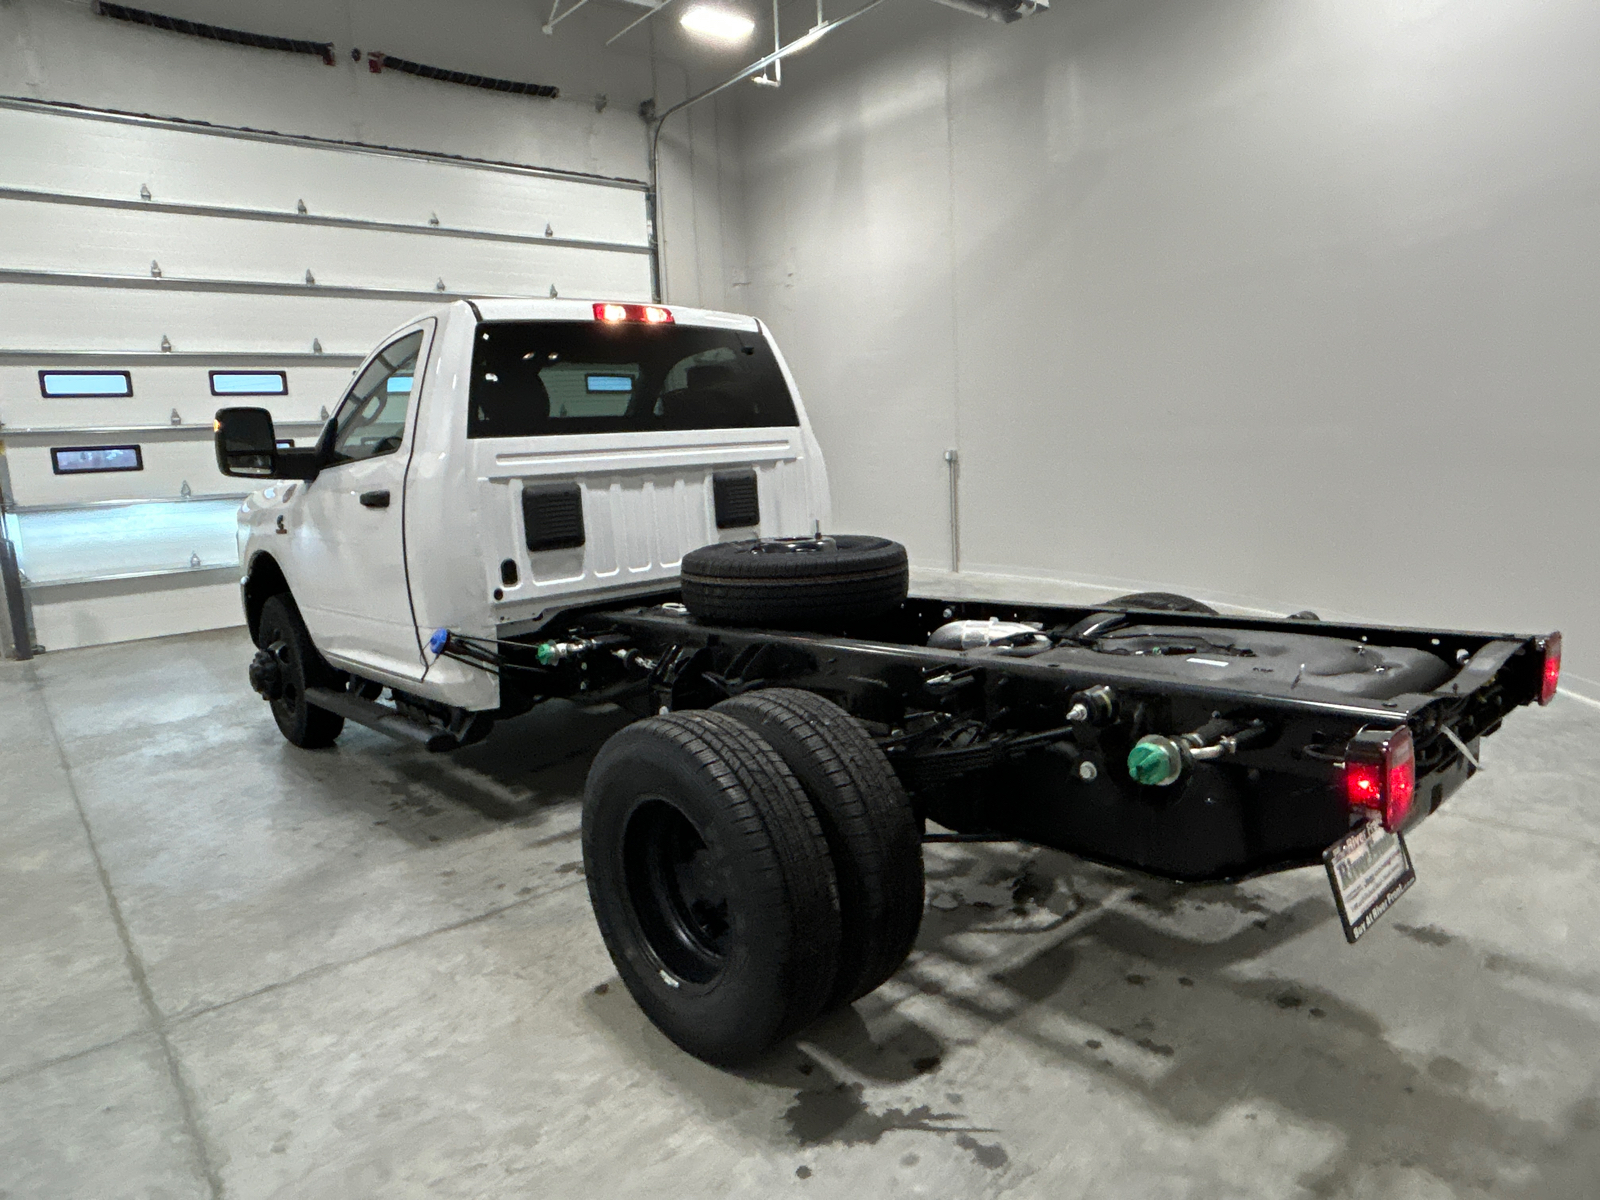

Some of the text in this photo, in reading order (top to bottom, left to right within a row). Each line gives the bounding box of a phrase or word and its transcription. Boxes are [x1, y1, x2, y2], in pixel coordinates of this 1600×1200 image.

[1353, 921, 1366, 939] Buy
[1365, 912, 1374, 928] At
[1372, 898, 1388, 919] River
